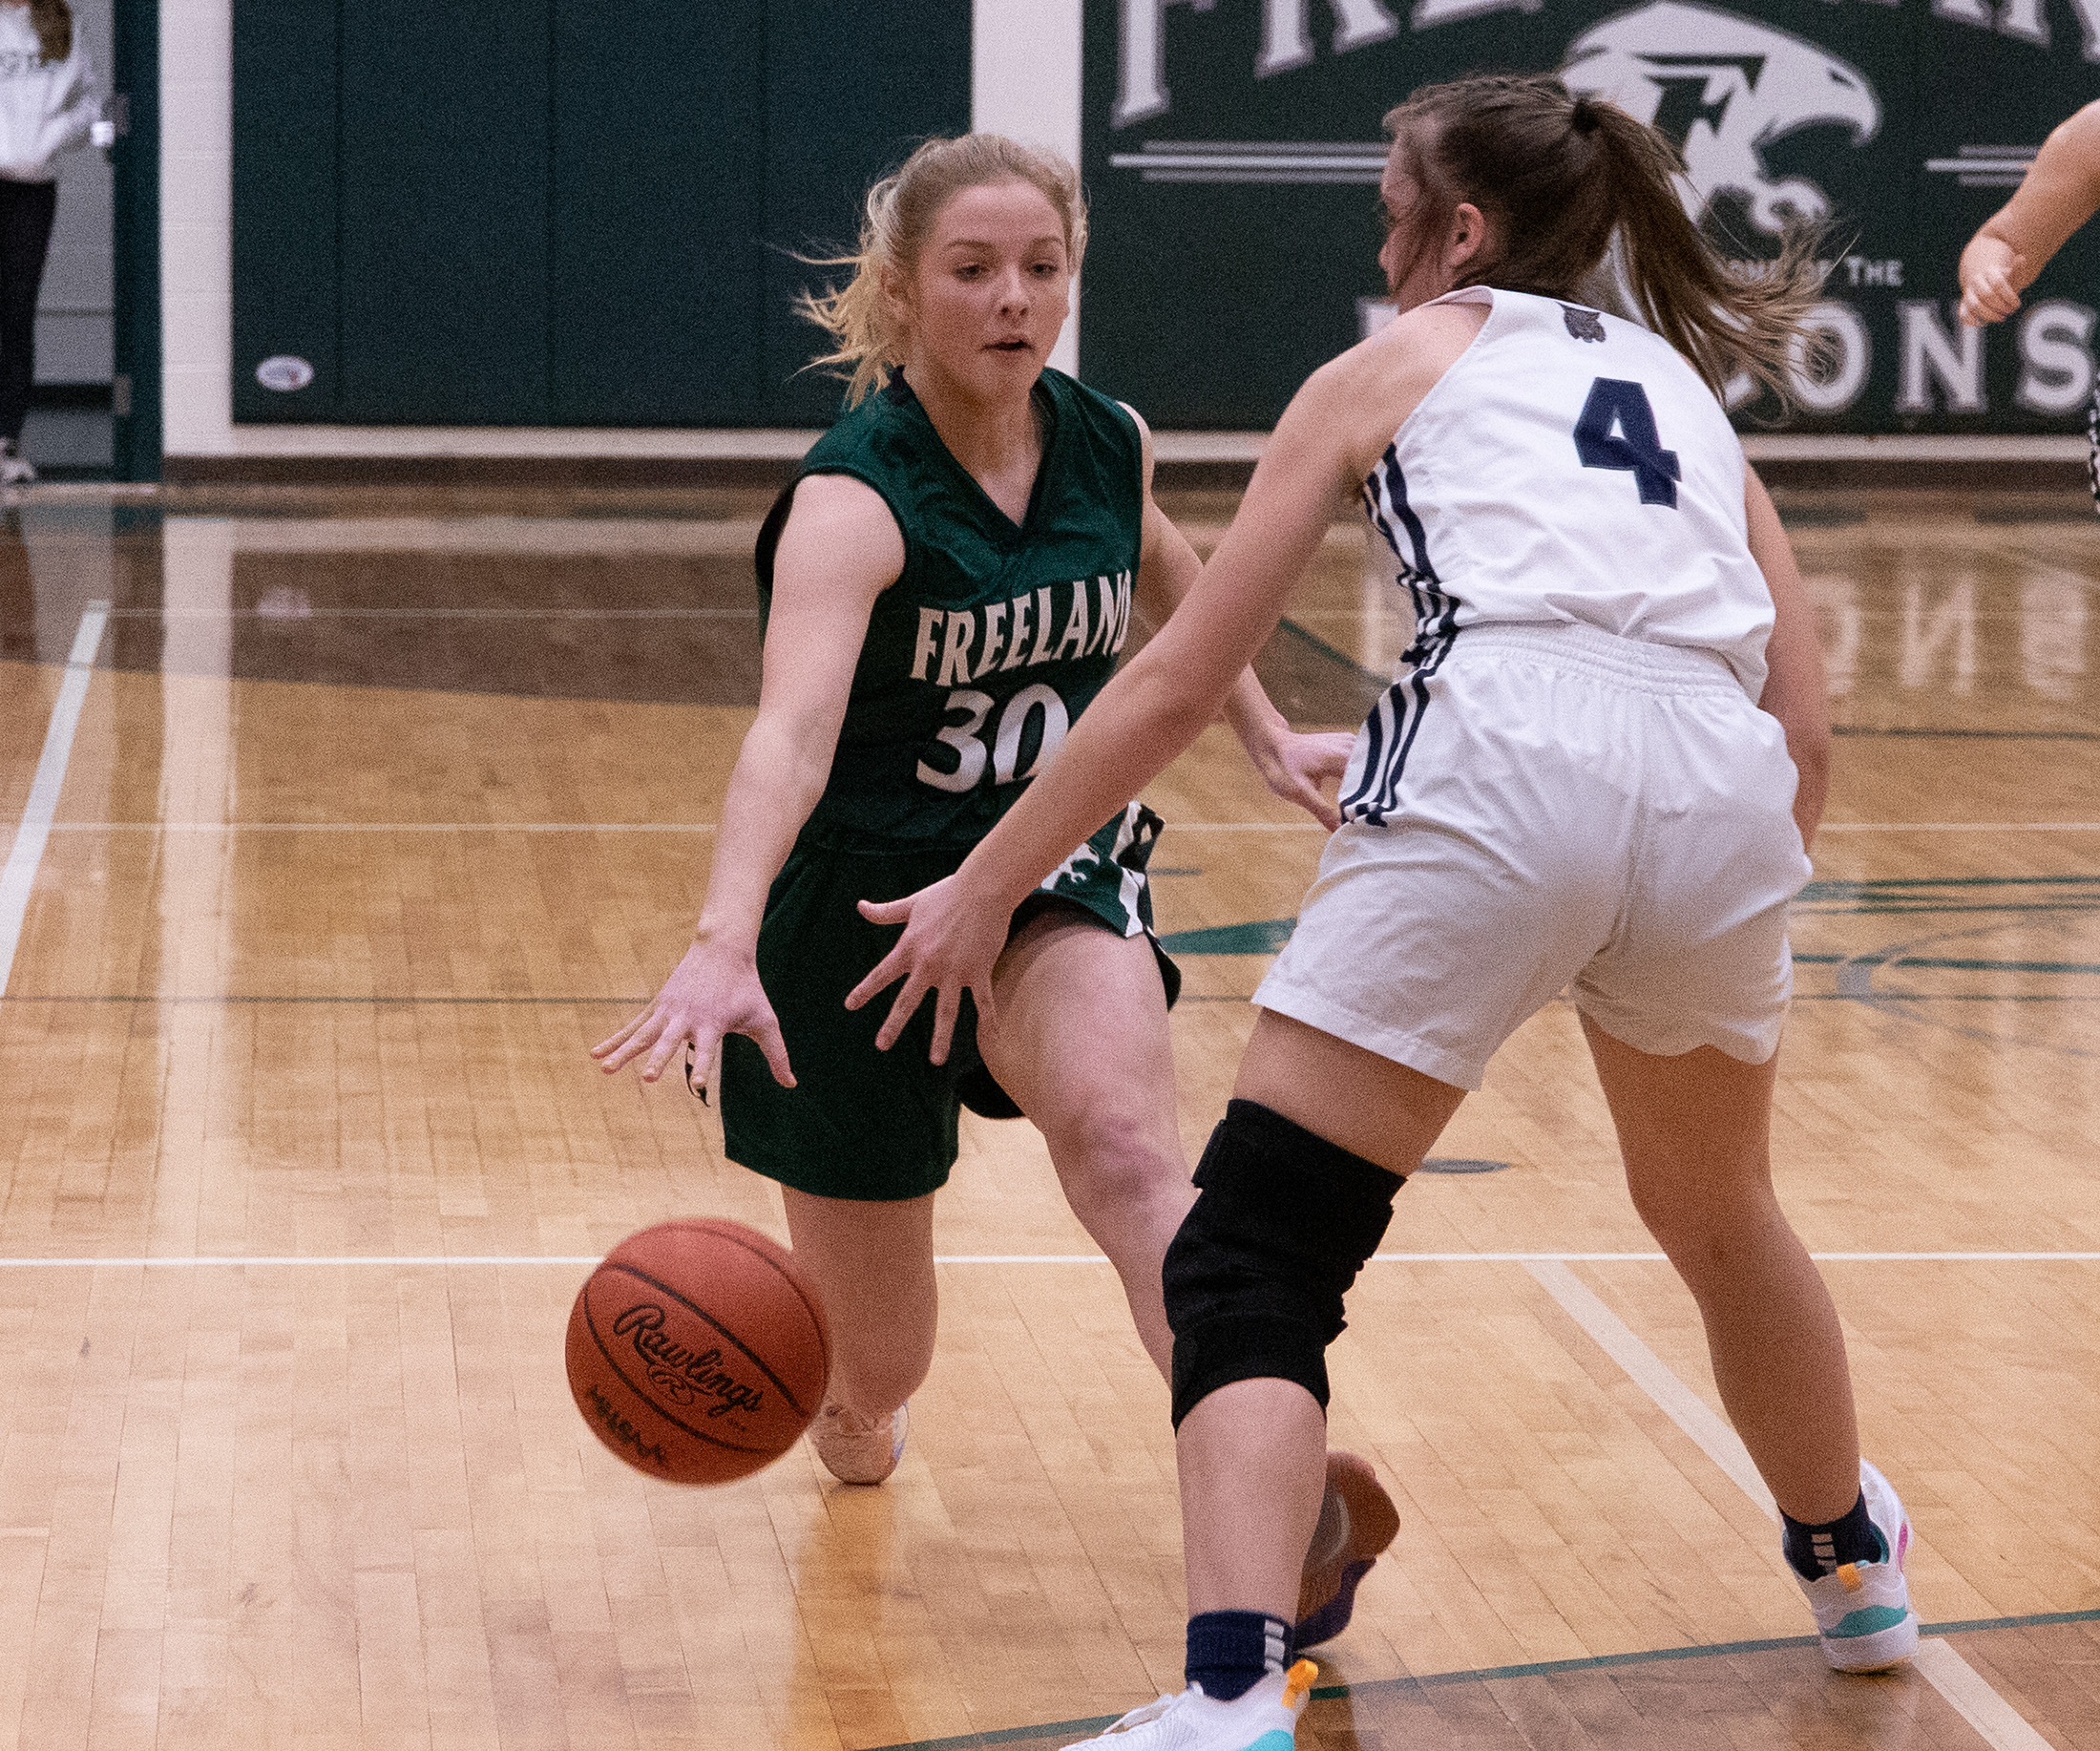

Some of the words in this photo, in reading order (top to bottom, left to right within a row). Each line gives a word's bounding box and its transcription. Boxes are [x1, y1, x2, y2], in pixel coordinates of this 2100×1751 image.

[1573, 376, 1683, 510] 4
[916, 683, 1069, 792] 30
[614, 1304, 764, 1417] Rawlings
